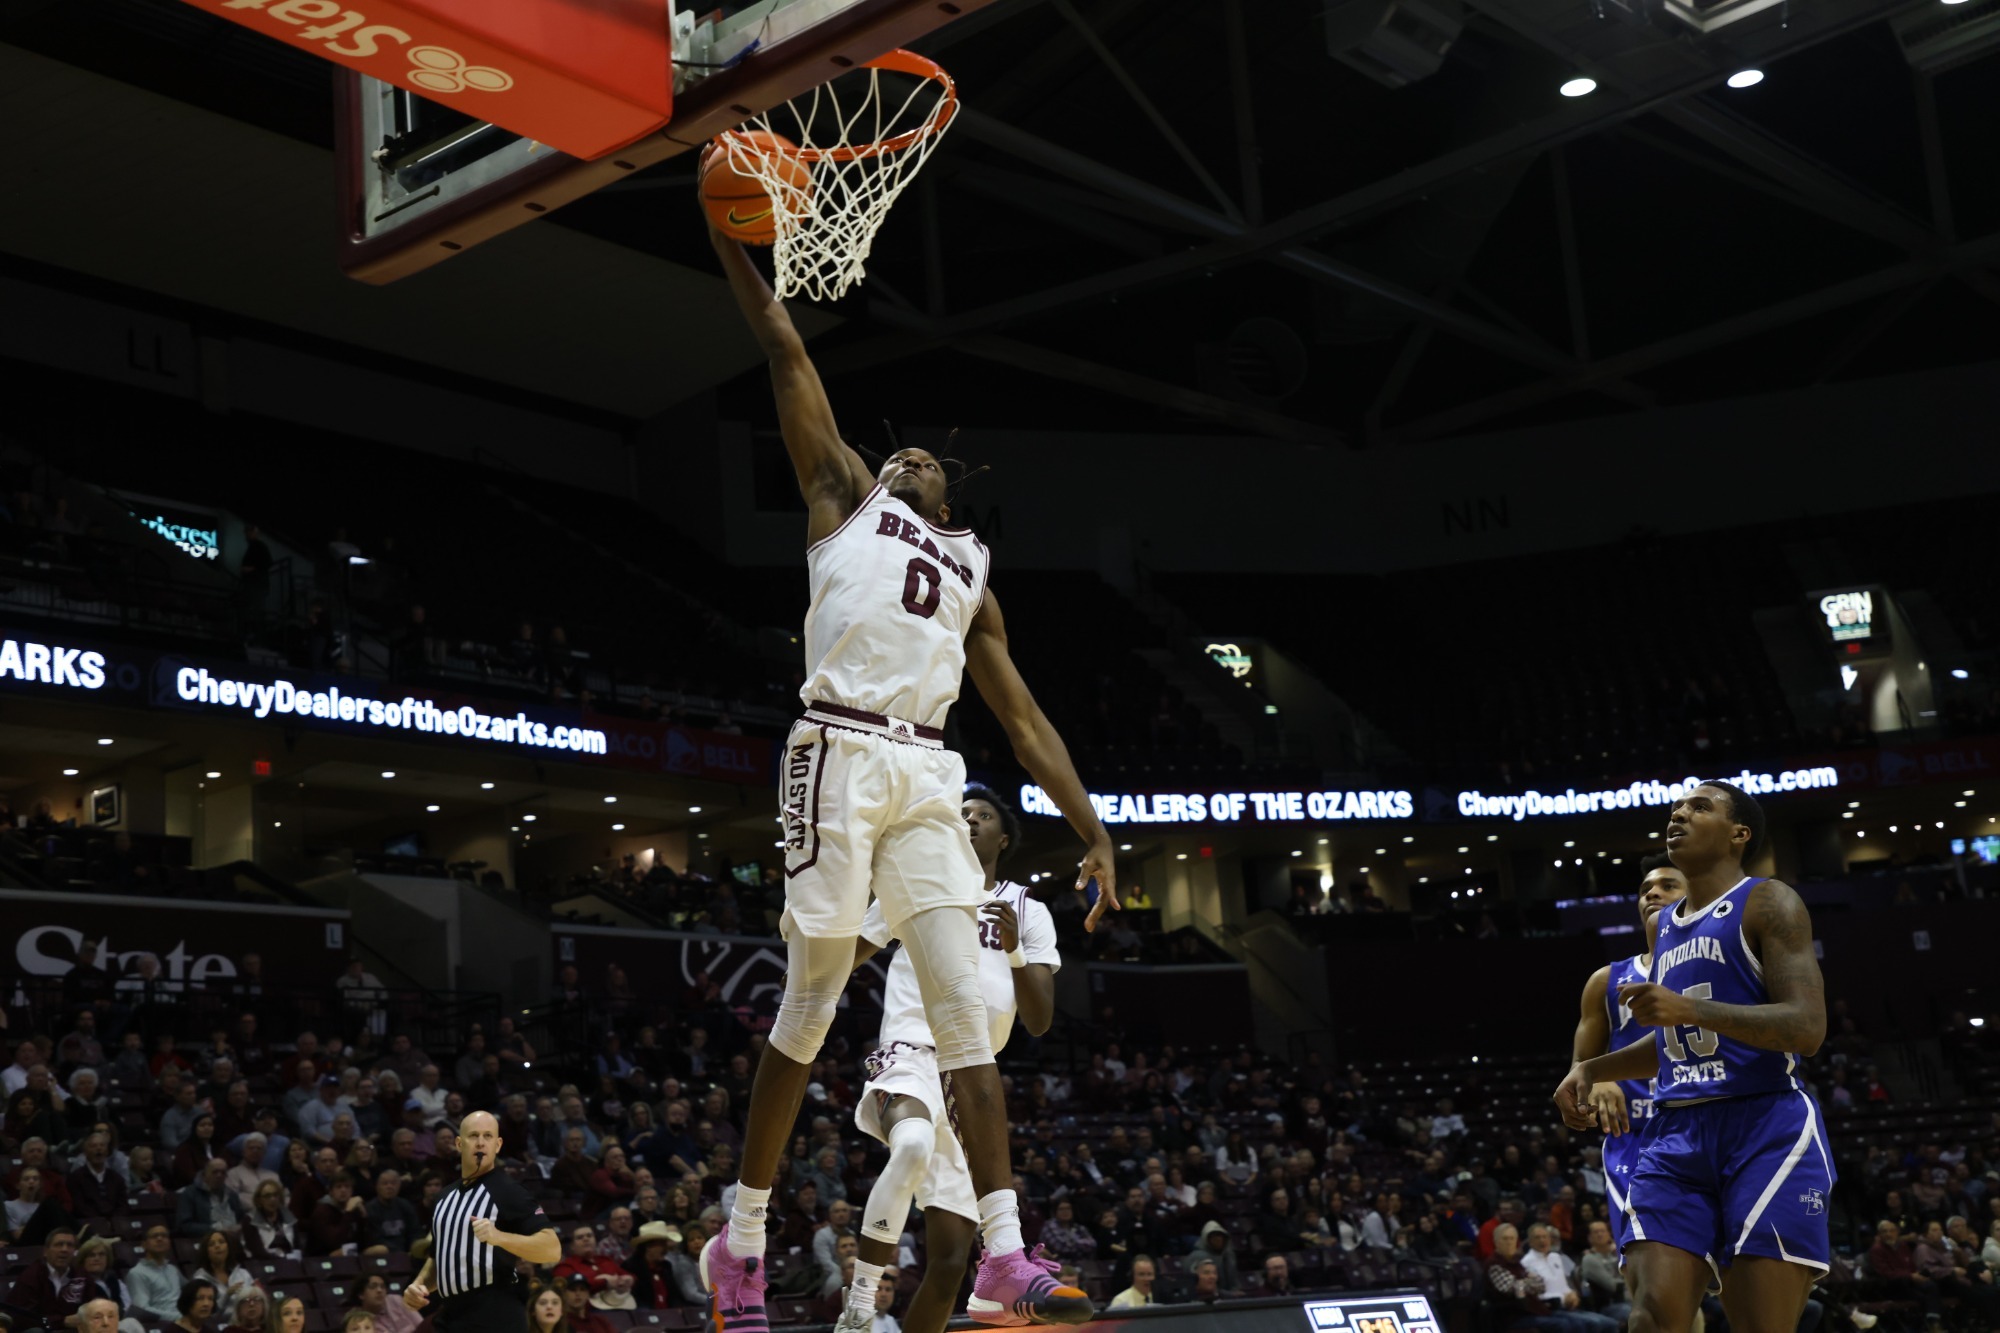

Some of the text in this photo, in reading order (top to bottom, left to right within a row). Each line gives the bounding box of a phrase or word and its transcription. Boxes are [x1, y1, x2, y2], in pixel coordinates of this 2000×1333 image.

[876, 511, 974, 589] BEARS
[901, 557, 942, 620] 0
[176, 667, 608, 755] ChevyDealersoftheOzarks.com
[607, 731, 757, 774] ACO BELL
[790, 742, 814, 779] MO
[1210, 793, 1246, 821] OF
[1249, 792, 1304, 820] THE
[1306, 790, 1414, 820] OZARKS
[15, 925, 239, 992] State
[1657, 935, 1727, 986] INDIANA
[1672, 1060, 1728, 1087] STATE
